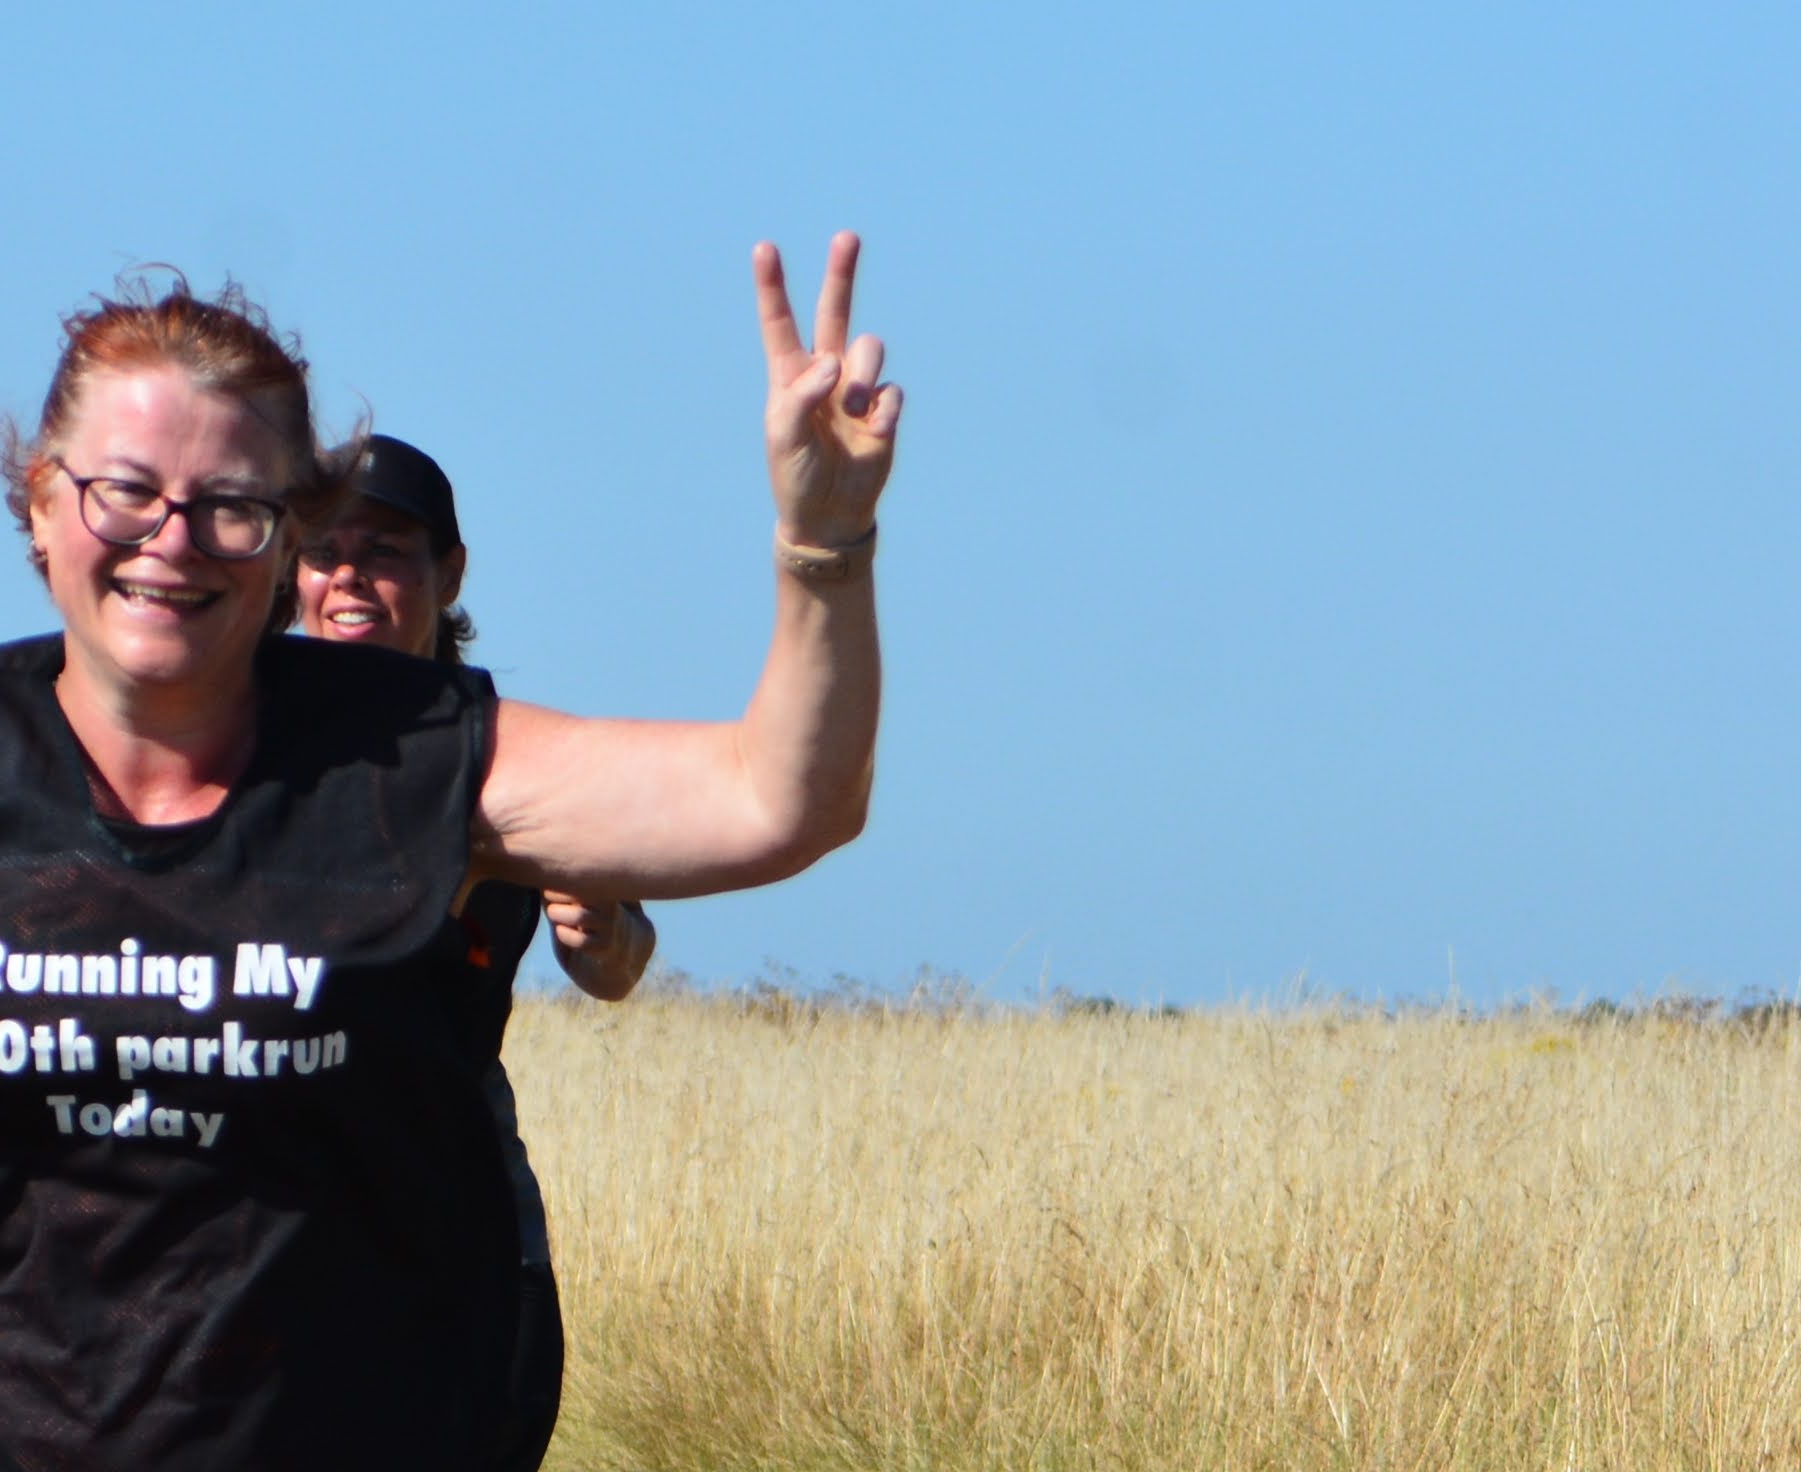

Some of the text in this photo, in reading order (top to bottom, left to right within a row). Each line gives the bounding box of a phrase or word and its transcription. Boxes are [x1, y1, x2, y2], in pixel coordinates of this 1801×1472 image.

[233, 943, 323, 1009] My
[116, 1021, 347, 1079] parkrun
[47, 1089, 225, 1147] Today
